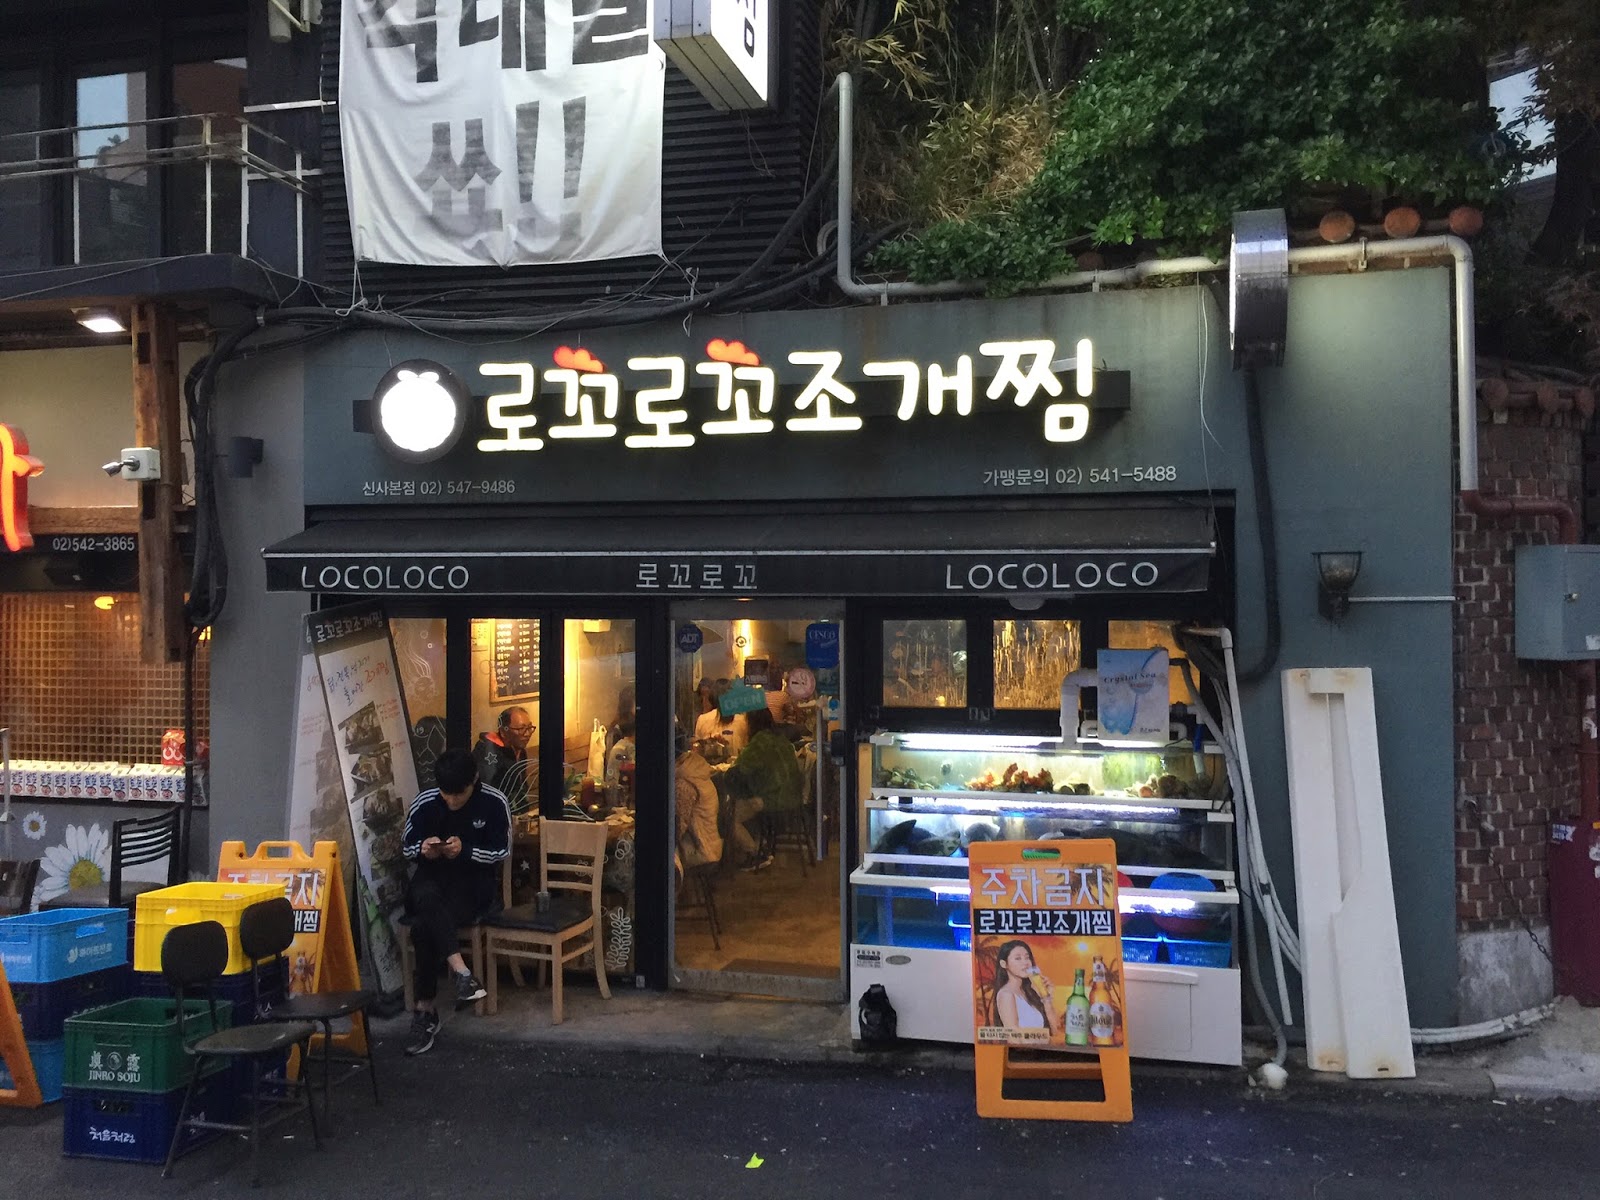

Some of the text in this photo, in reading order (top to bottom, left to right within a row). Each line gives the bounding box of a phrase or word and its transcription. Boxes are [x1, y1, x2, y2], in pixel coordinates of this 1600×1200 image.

[477, 338, 1094, 452] 로꼬로꼬조개찜
[362, 480, 516, 496] 신사본점 02) 547-9486
[983, 466, 1177, 487] 가맹문의 02) 541-5488
[52, 536, 135, 551] 02)542-3865
[301, 565, 469, 590] LOCOLOCO
[636, 563, 758, 590] 로꼬로꼬
[945, 562, 1159, 590] LOCOLOCO
[680, 633, 699, 644] ADT
[981, 867, 1104, 907] 주차금지
[978, 909, 1112, 936] 로꼬로꼬조개찜
[88, 1070, 141, 1083] JINRO SOJU
[89, 1126, 136, 1144] 처음처럼
